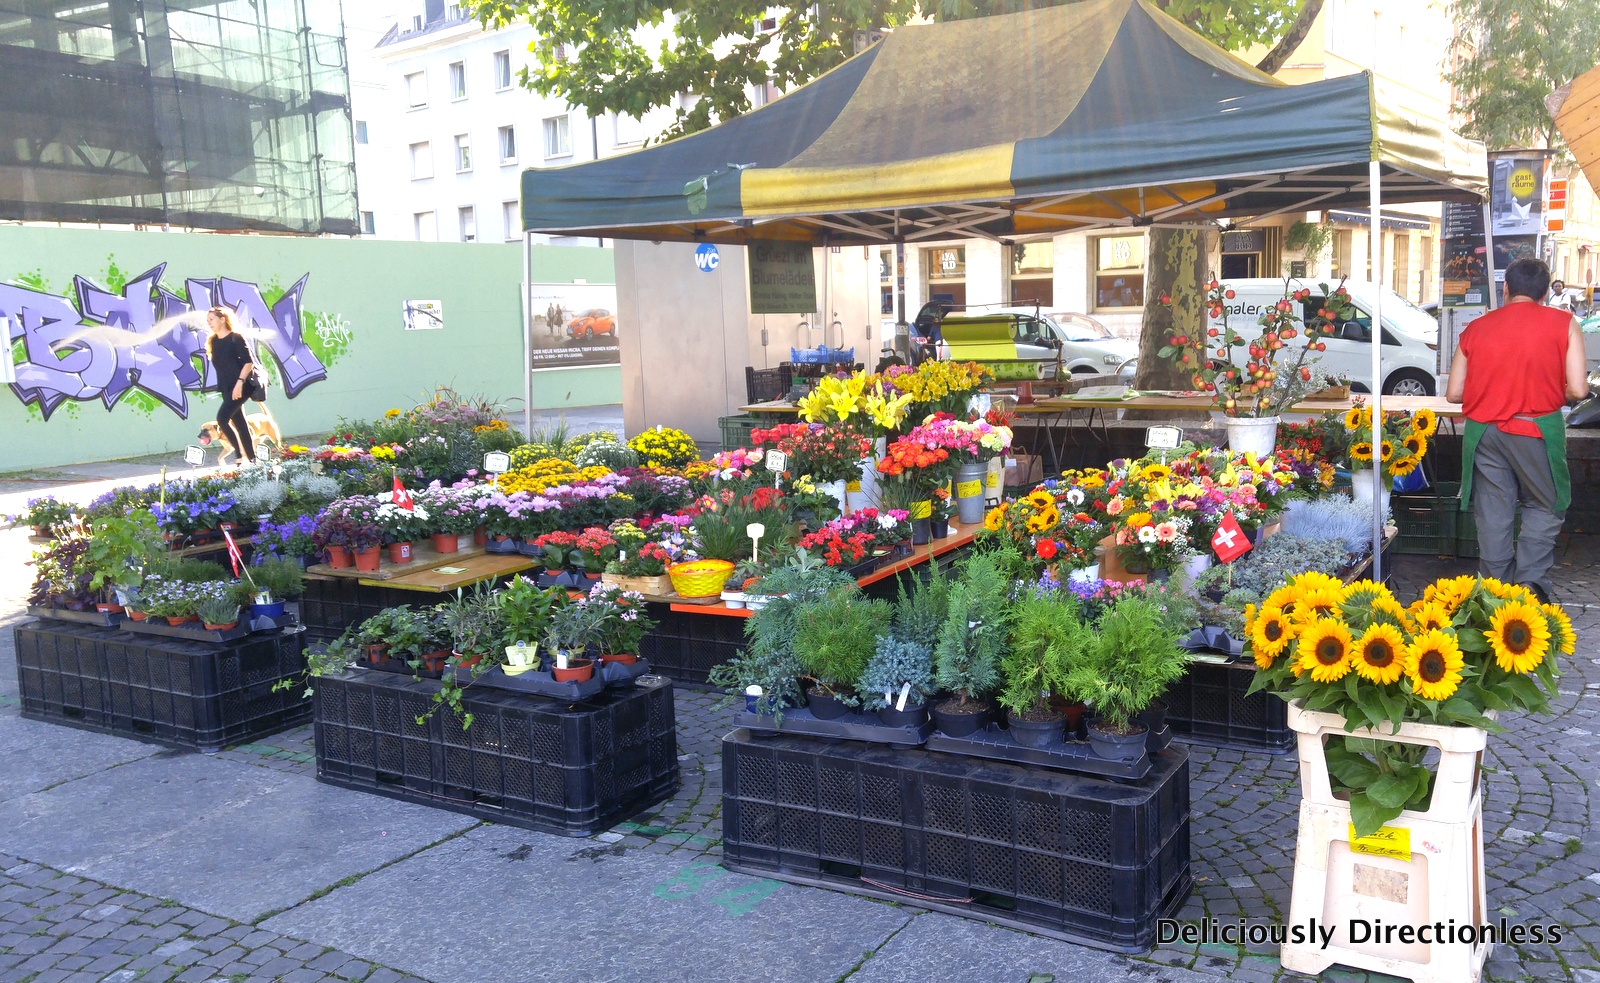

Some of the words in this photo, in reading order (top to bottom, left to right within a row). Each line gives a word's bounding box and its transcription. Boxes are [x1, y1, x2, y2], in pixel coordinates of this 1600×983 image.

[1515, 174, 1532, 183] gast
[1511, 181, 1535, 189] räume
[695, 253, 719, 269] WC
[752, 268, 814, 286] Blumelädeli
